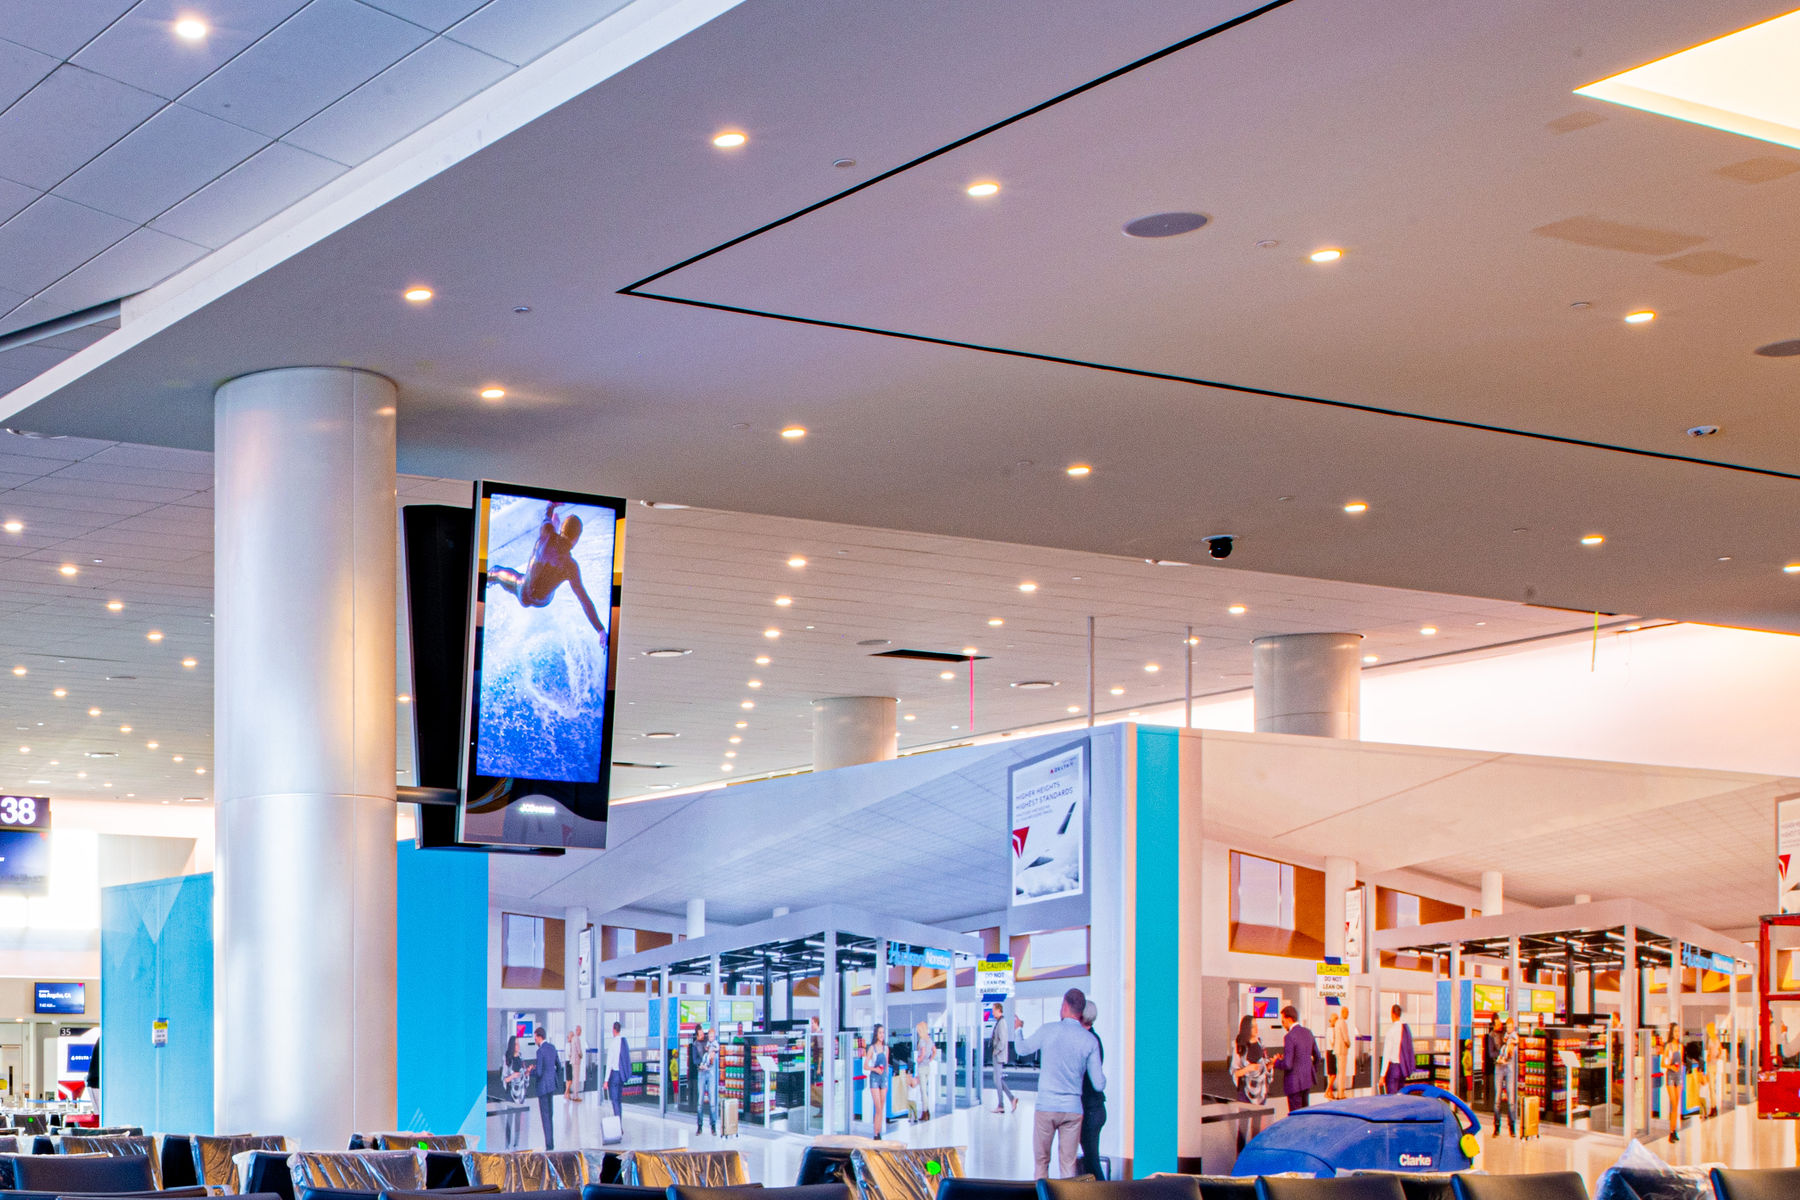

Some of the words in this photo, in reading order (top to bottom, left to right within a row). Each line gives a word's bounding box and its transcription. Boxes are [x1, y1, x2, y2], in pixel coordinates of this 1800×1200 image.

[0, 797, 36, 825] 38
[1325, 965, 1349, 973] CAUTION
[61, 1028, 72, 1036] 35
[1399, 1153, 1432, 1166] Clarke
